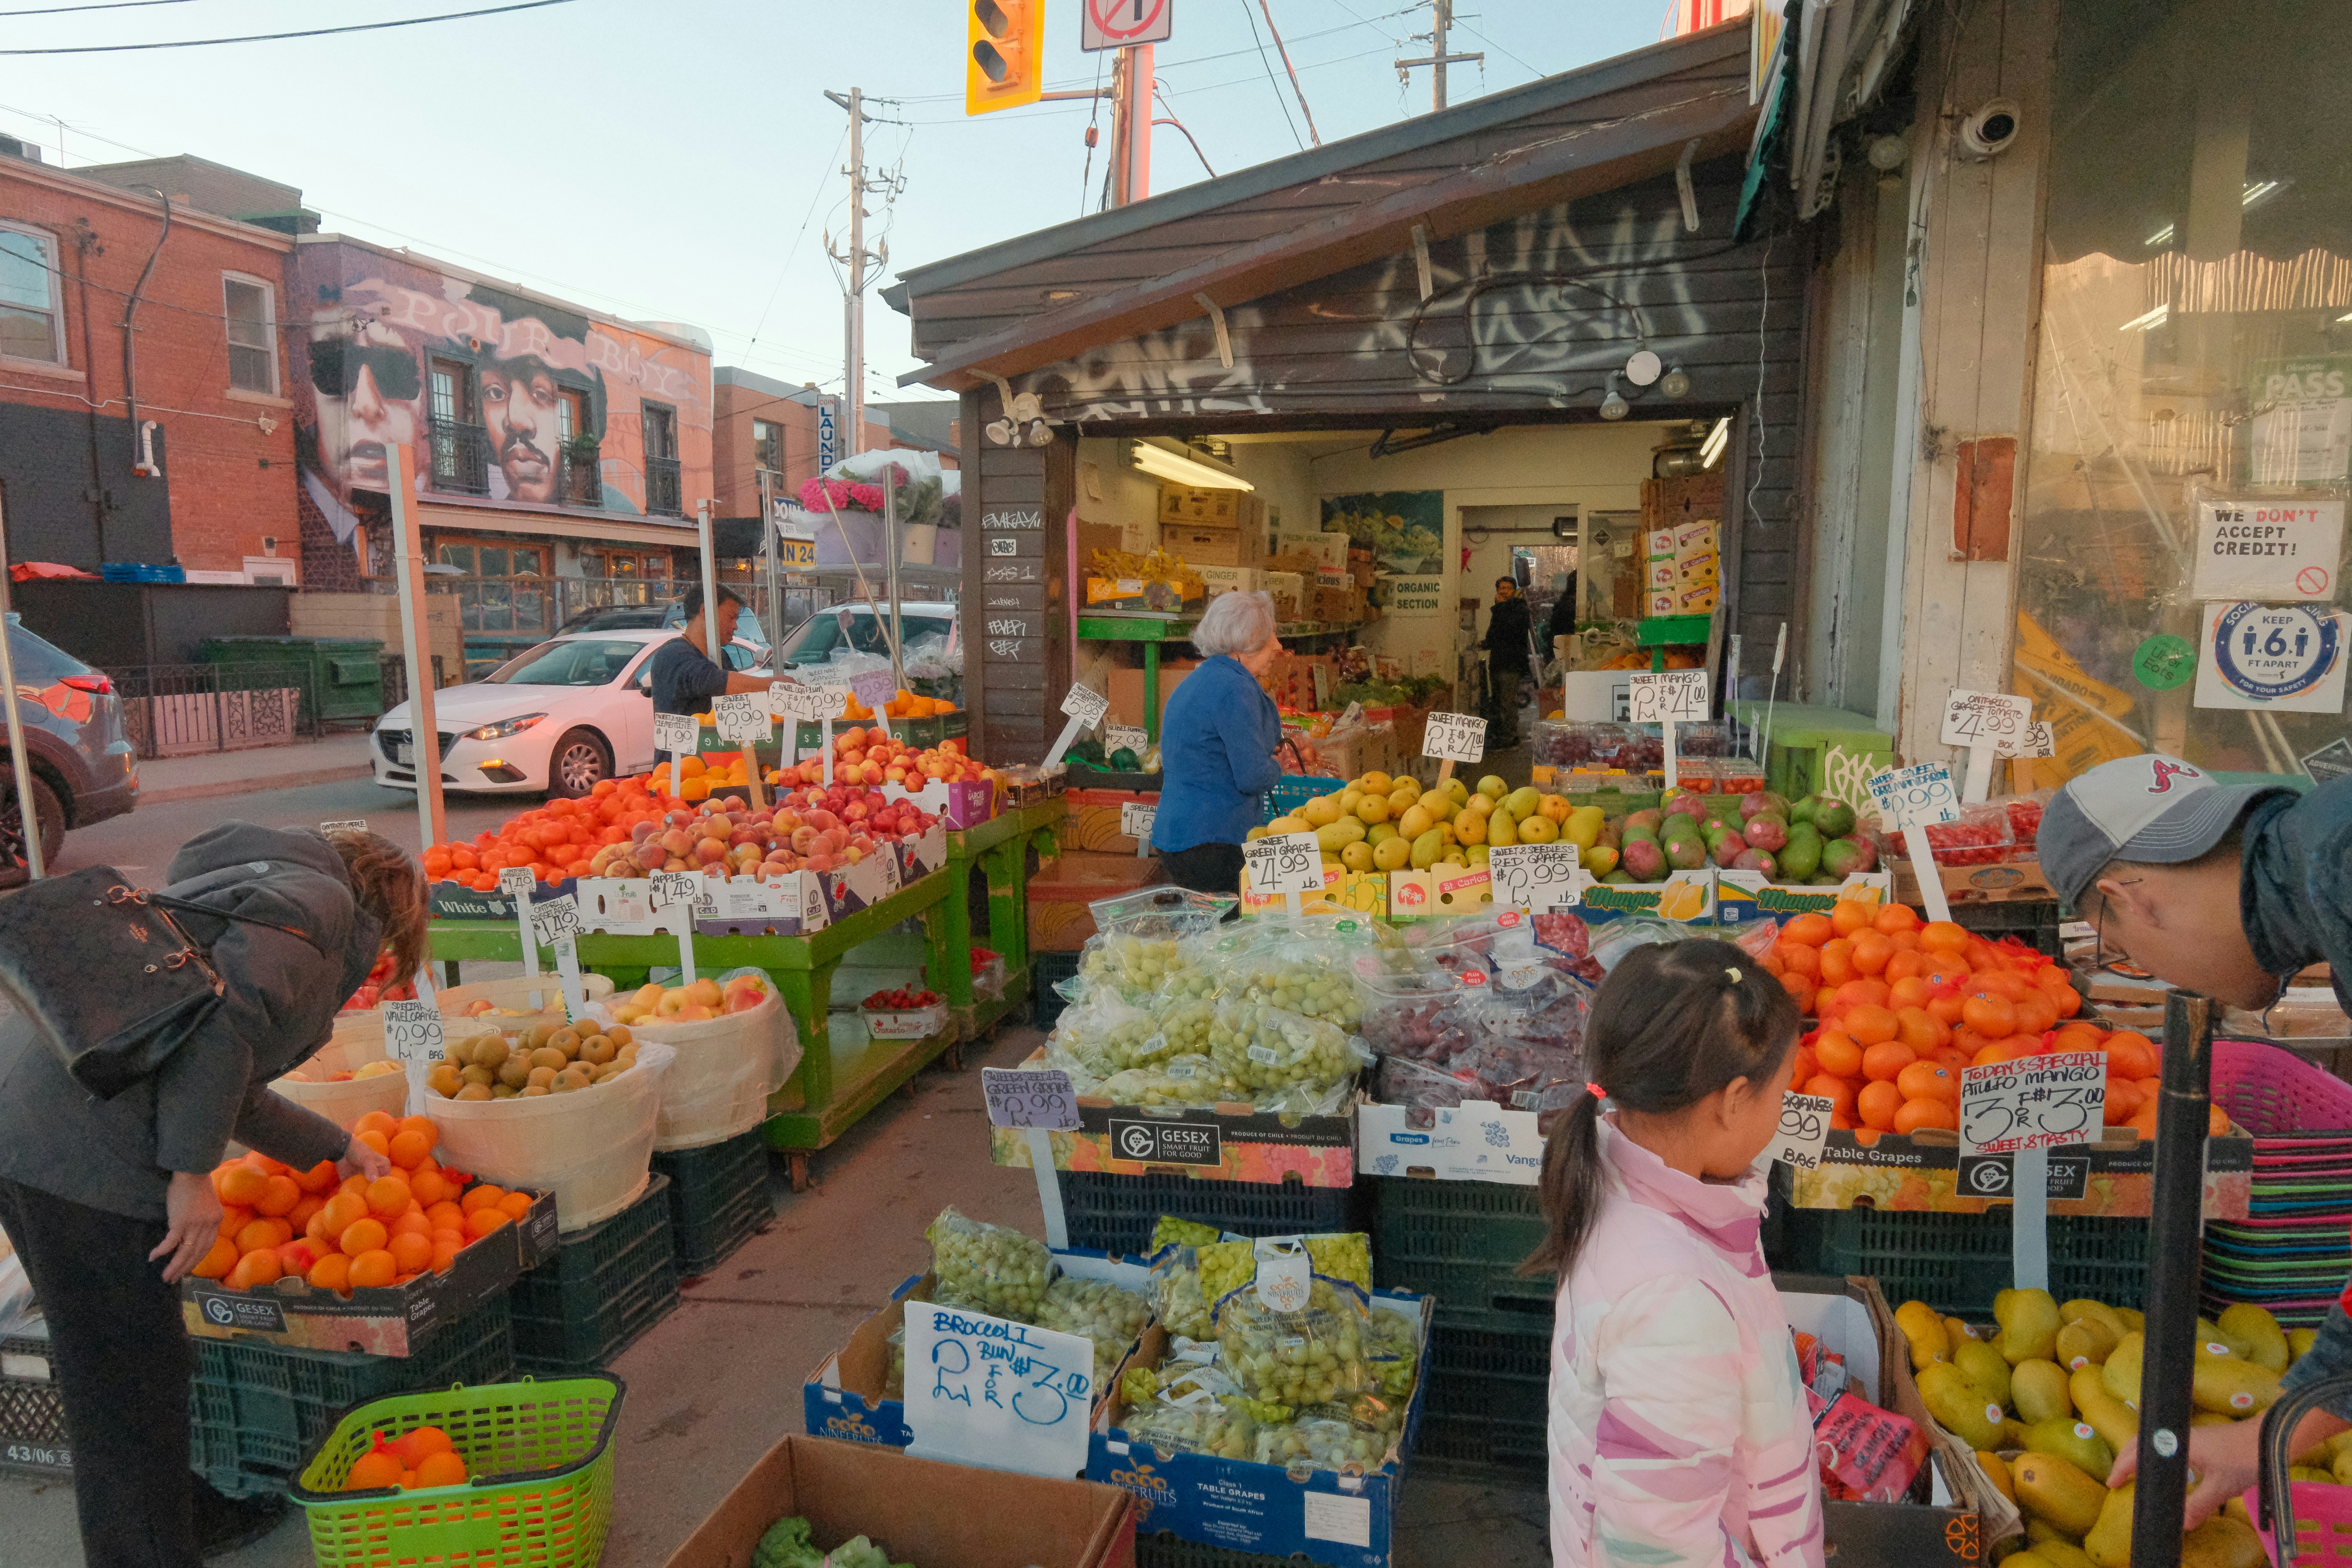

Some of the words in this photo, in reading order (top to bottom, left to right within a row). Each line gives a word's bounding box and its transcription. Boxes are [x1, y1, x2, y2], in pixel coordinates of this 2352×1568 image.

[602, 333, 680, 400] BOY
[2266, 370, 2344, 399] PASS
[2215, 509, 2244, 522] WE
[2255, 509, 2318, 522] DON'T
[2216, 526, 2286, 539] ACCEPT
[799, 545, 815, 564] 24
[2213, 541, 2297, 556] CREDIT!
[1207, 570, 1238, 581] GINGER
[1396, 580, 1441, 594] ORGANIC
[1396, 598, 1439, 610] SECTION
[2226, 603, 2258, 626] SOCIA
[2262, 616, 2294, 625] KEEP
[2264, 628, 2287, 657] 6
[2151, 645, 2182, 669] Uber
[2263, 660, 2299, 669] APART
[1630, 675, 1657, 684] SWEET
[1660, 673, 1701, 684] MANGO
[2239, 679, 2254, 689] FOR
[2278, 678, 2306, 693] SAFETY
[722, 694, 749, 703] SWEET
[771, 692, 786, 714] 3
[1968, 695, 2012, 708] ONTARIO
[715, 702, 752, 712] PEACH
[1951, 701, 1985, 714] GRAPE
[1082, 718, 1093, 728] BOX
[1427, 714, 1454, 725] SWEET
[1455, 717, 1487, 729] MANGO
[1257, 835, 1289, 846] SWEET
[1245, 846, 1276, 859] GREEN
[1279, 843, 1318, 855] GRAPE
[1490, 847, 1518, 857] SWEET
[1492, 858, 1524, 867] RED
[1528, 853, 1577, 863] GRAPE
[652, 873, 685, 884] APPLE
[1444, 882, 1456, 891] St.
[1457, 874, 1488, 887] Carlos
[1586, 886, 1661, 912] Mangos
[1757, 887, 1838, 913] Mangos
[438, 900, 487, 914] White
[391, 1002, 432, 1012] SPECIAL
[385, 1011, 411, 1022] NAVEL
[410, 1011, 442, 1022] ORANGE
[429, 1050, 444, 1060] BAG
[2027, 1052, 2107, 1072] SPECIAL
[2025, 1066, 2100, 1086] MANGO
[986, 1080, 1030, 1094] GREEN
[1964, 1097, 2014, 1144] 3
[1162, 1130, 1210, 1144] GESEX
[1396, 1135, 1423, 1144] Grapes
[1975, 1136, 2023, 1153] SWEET
[2037, 1129, 2090, 1147] TASTY
[1782, 1147, 1816, 1169] BAG
[1824, 1146, 1865, 1160] Table
[1869, 1150, 1922, 1165] Grapes
[236, 1303, 275, 1316] GESEX
[410, 1297, 430, 1313] Table
[410, 1302, 435, 1321] Grapes
[933, 1312, 1045, 1350] BROCCOLI
[8, 1445, 55, 1465] 43/06
[1218, 1479, 1236, 1487] Class
[1197, 1482, 1226, 1494] TABLE
[1228, 1488, 1265, 1501] GRAPES
[1203, 1501, 1224, 1509] Produce
